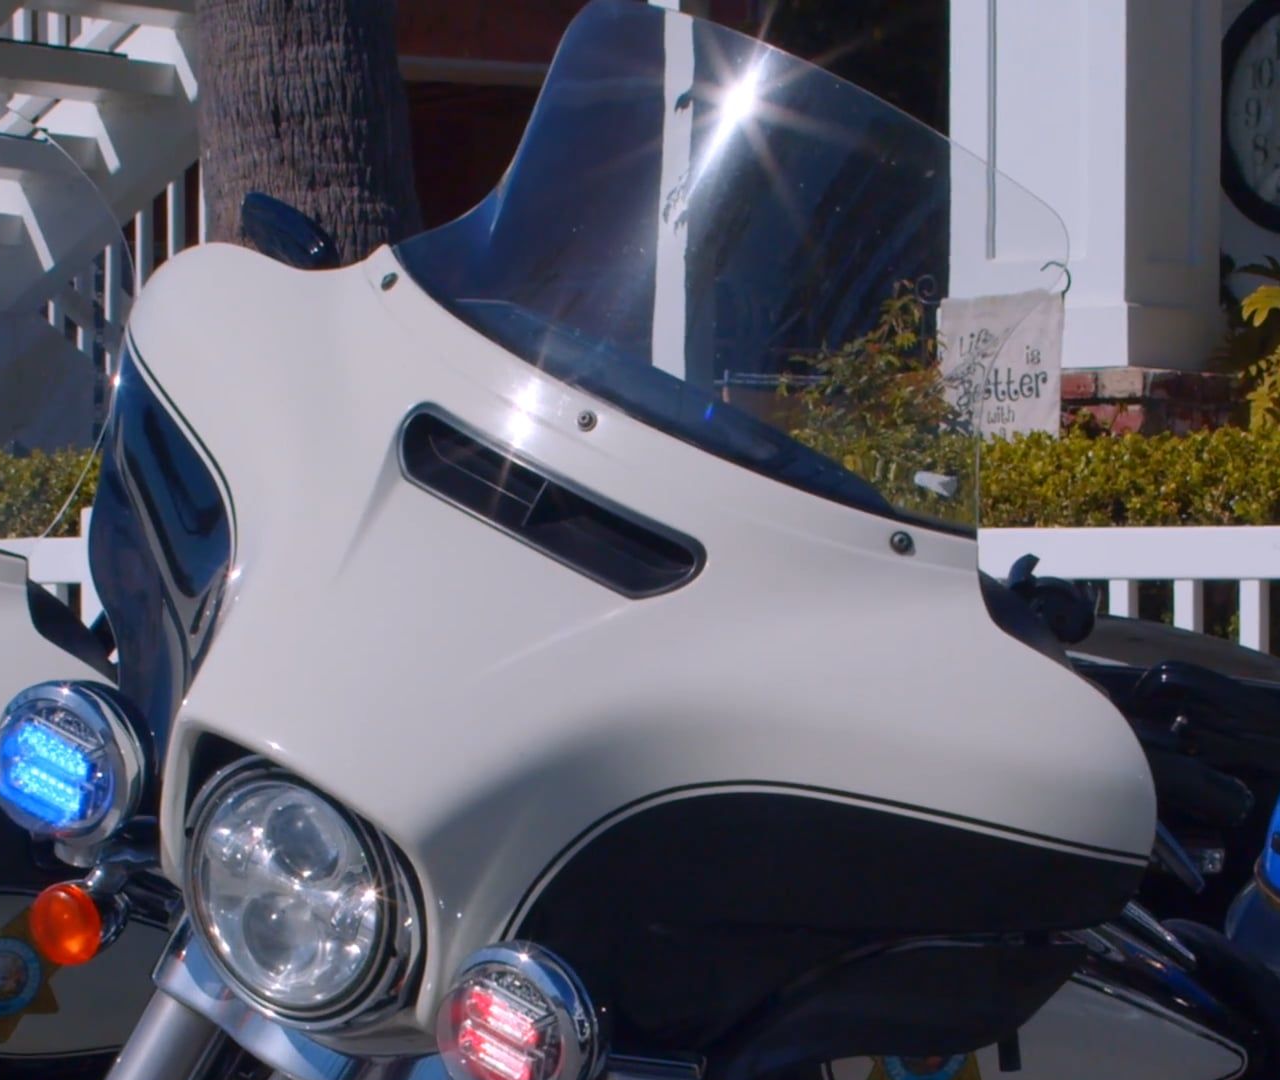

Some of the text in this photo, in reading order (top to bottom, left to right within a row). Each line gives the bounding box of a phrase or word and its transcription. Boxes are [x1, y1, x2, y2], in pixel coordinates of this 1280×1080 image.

[1249, 56, 1274, 90] 10
[1244, 97, 1262, 128] 9
[1024, 344, 1041, 365] is
[986, 404, 1015, 424] with
